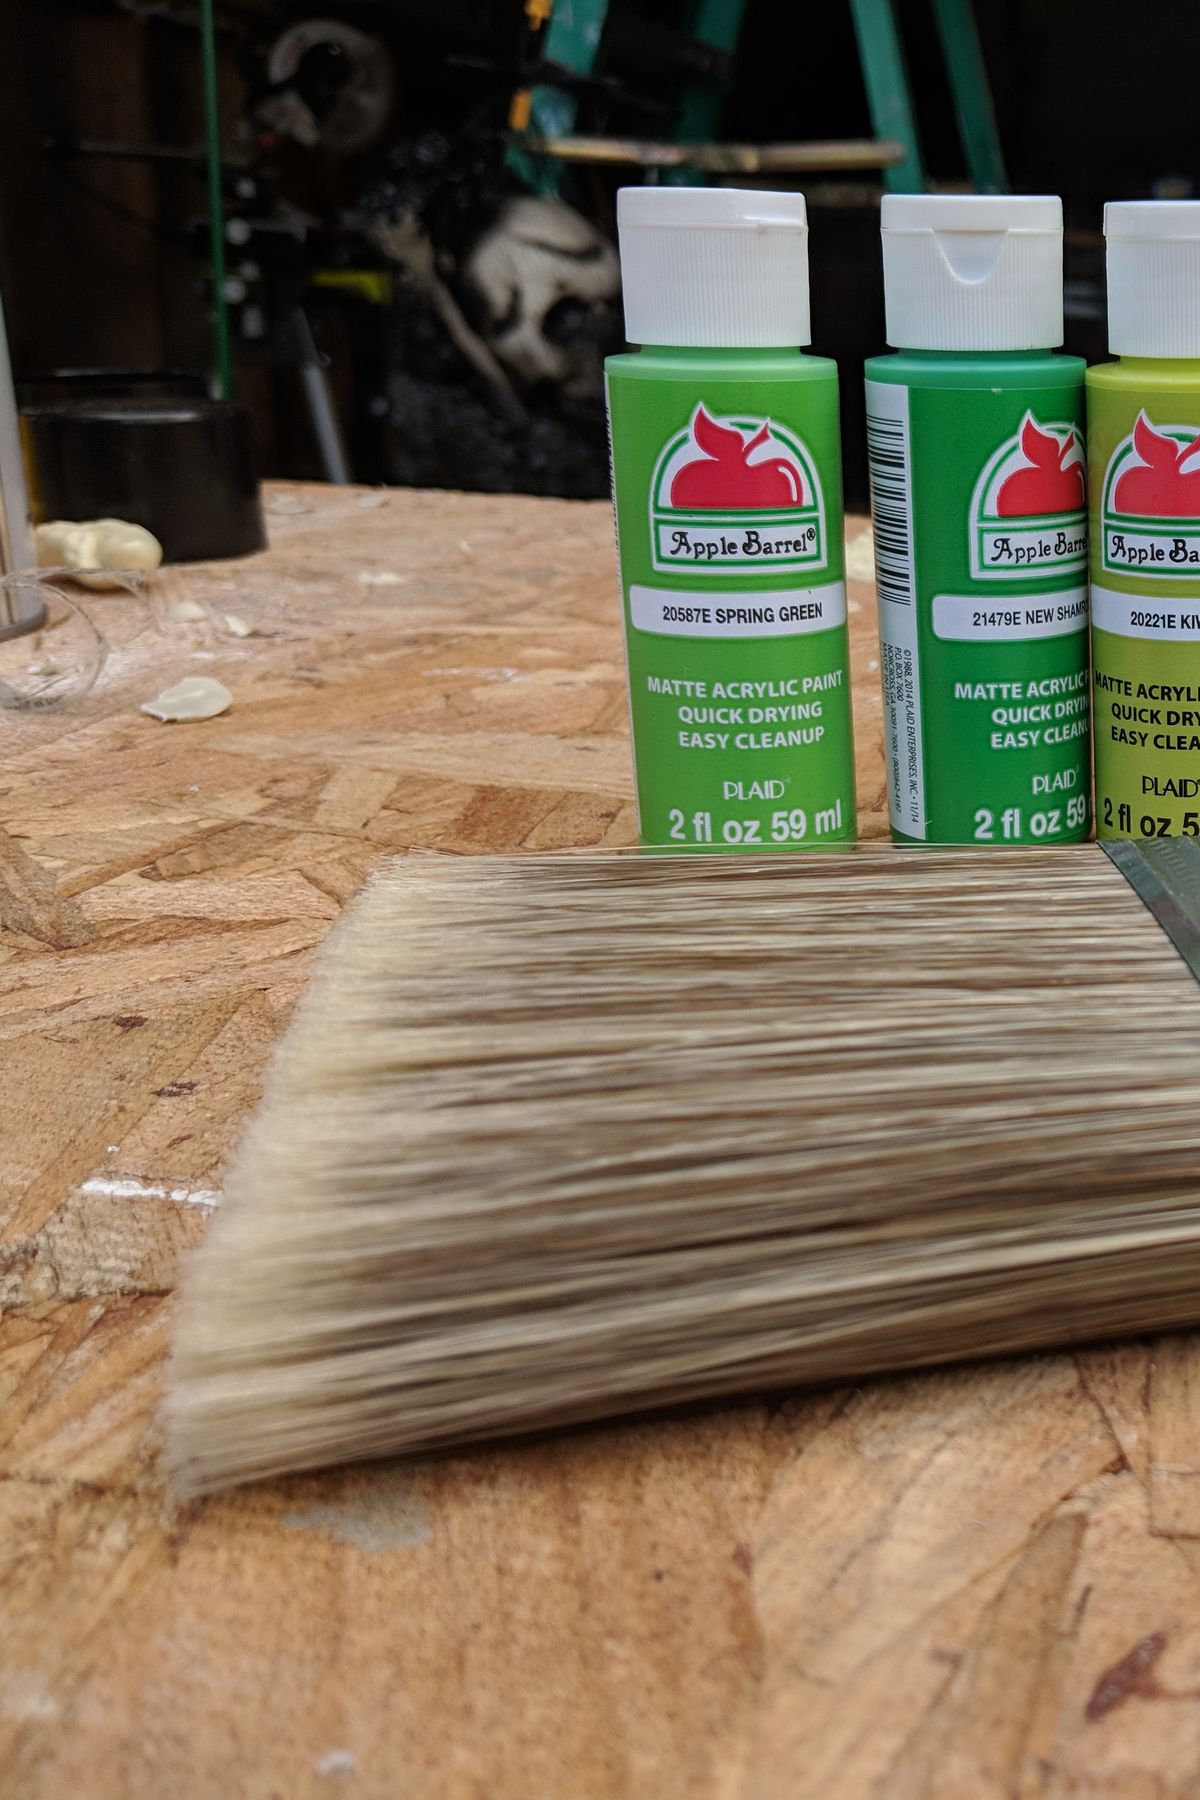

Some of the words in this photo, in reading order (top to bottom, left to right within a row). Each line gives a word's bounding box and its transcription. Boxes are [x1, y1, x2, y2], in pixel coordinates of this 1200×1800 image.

[670, 531, 738, 560] Apple
[991, 537, 1051, 564] Apple
[1054, 532, 1088, 556] Barre
[1111, 535, 1164, 564] Apple
[663, 606, 711, 624] 20587E
[716, 607, 774, 624] SPRING
[778, 602, 822, 621] GREEN
[973, 611, 1021, 626] 21479E
[1026, 608, 1054, 625] NEW
[1130, 611, 1176, 629] 20221E
[896, 662, 904, 680] BOX
[1096, 670, 1132, 696] MATTE
[648, 676, 707, 698] MATTE
[712, 680, 798, 698] ACRYLIC
[802, 670, 842, 694] PAINT
[896, 681, 904, 702] 7600
[904, 678, 914, 699] 2014
[955, 682, 1022, 699] MATTE
[1026, 671, 1084, 698] ACRYLIC
[678, 706, 744, 724] QUICK
[749, 702, 822, 724] DRYING
[905, 700, 916, 725] PLAID
[992, 706, 1051, 725] QUICK
[1055, 695, 1088, 718] DRYIN
[1112, 702, 1162, 725] QUICK
[678, 731, 730, 750] EASY
[735, 726, 825, 750] CLEANUP
[991, 730, 1039, 749] EASY
[1044, 718, 1088, 744] CLEANU
[1112, 726, 1148, 747] EASY
[669, 808, 686, 840] 2
[692, 811, 712, 842] fl
[722, 820, 762, 843] oz
[772, 808, 807, 842] 59
[815, 799, 842, 835] ml
[910, 801, 919, 823] 11/14
[974, 809, 994, 839] 2
[1001, 808, 1021, 838] fl
[1030, 809, 1061, 836] oz
[1066, 794, 1086, 829] 59
[1104, 798, 1114, 828] 2
[1118, 803, 1132, 834] fl
[1140, 815, 1172, 838] oz
